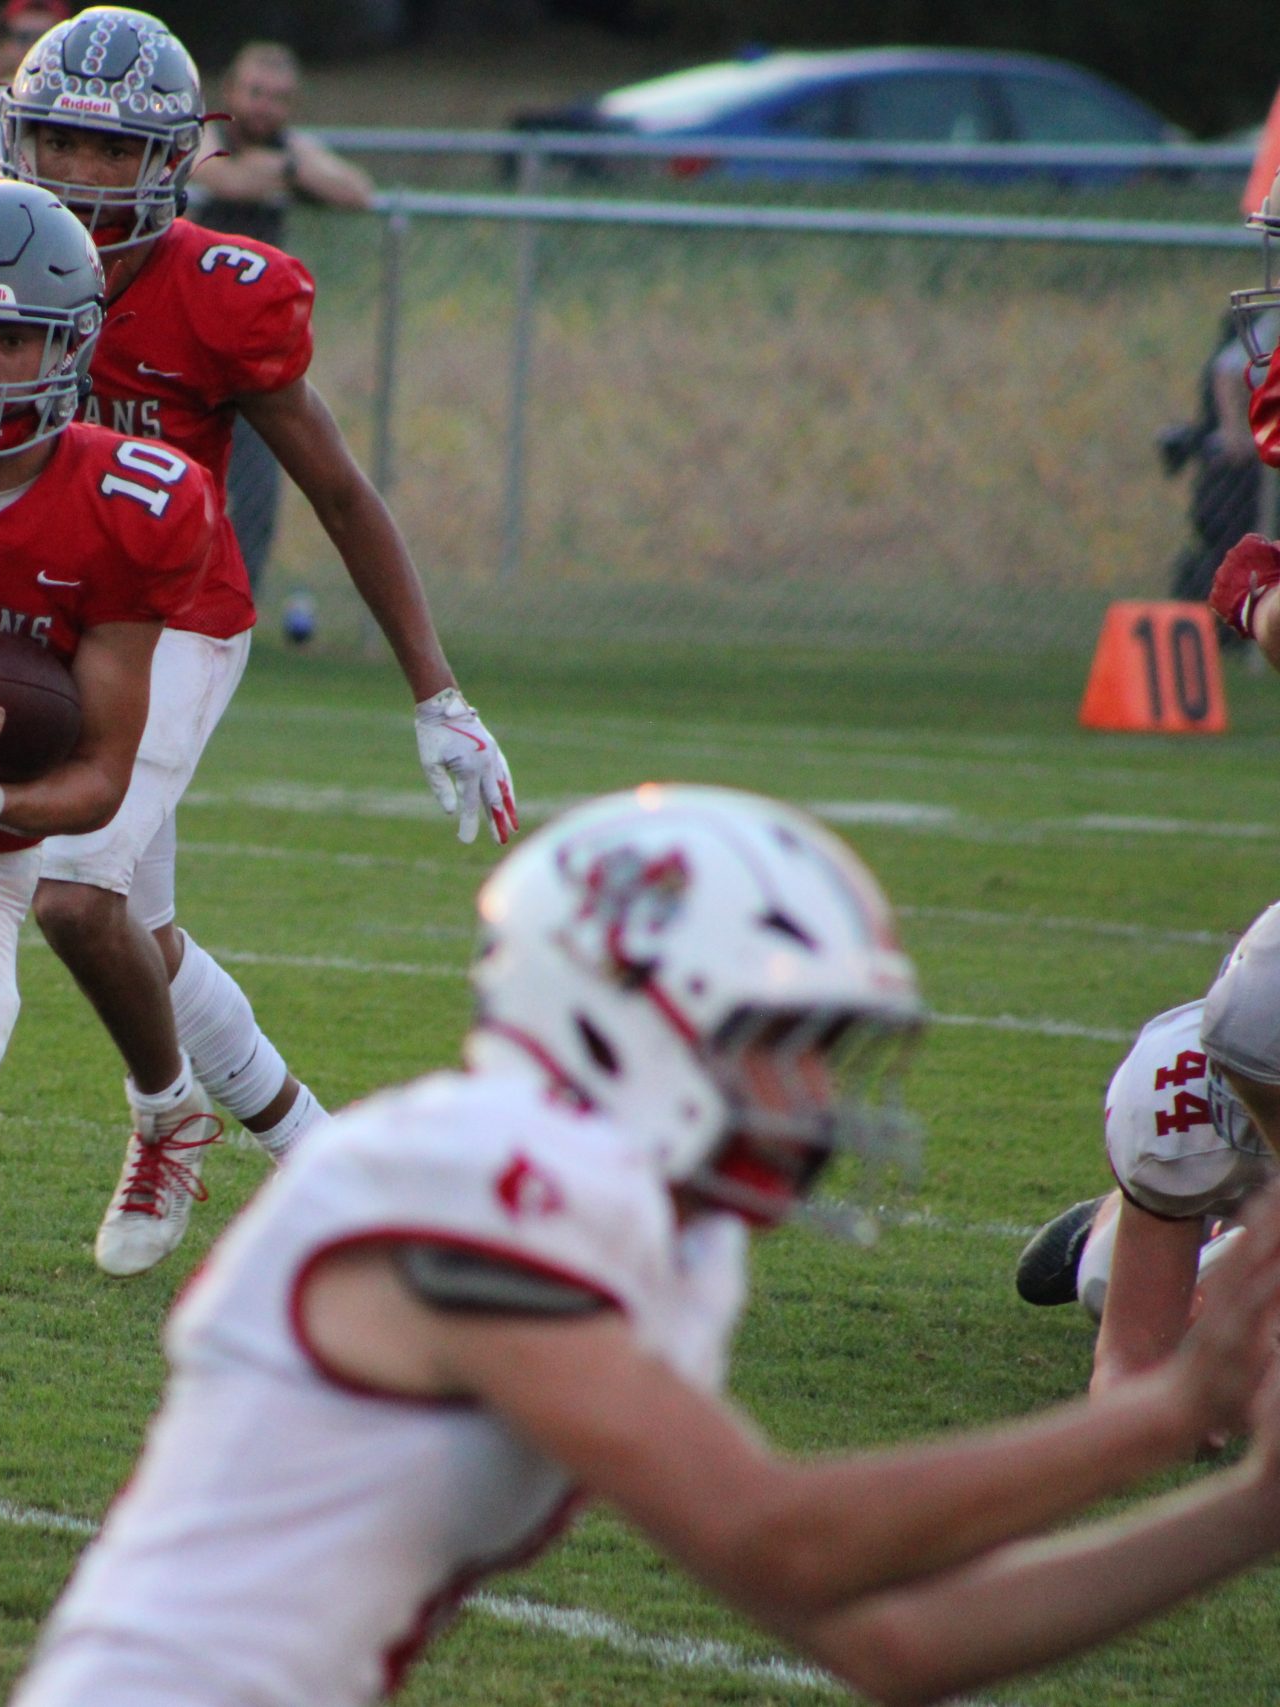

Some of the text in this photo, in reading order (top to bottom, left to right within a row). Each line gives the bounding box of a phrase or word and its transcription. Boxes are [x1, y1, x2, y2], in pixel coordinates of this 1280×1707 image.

[61, 96, 111, 113] Riddell
[199, 244, 268, 284] 3
[99, 441, 187, 518] 10
[1133, 616, 1208, 721] 10
[1154, 1050, 1220, 1137] 44
